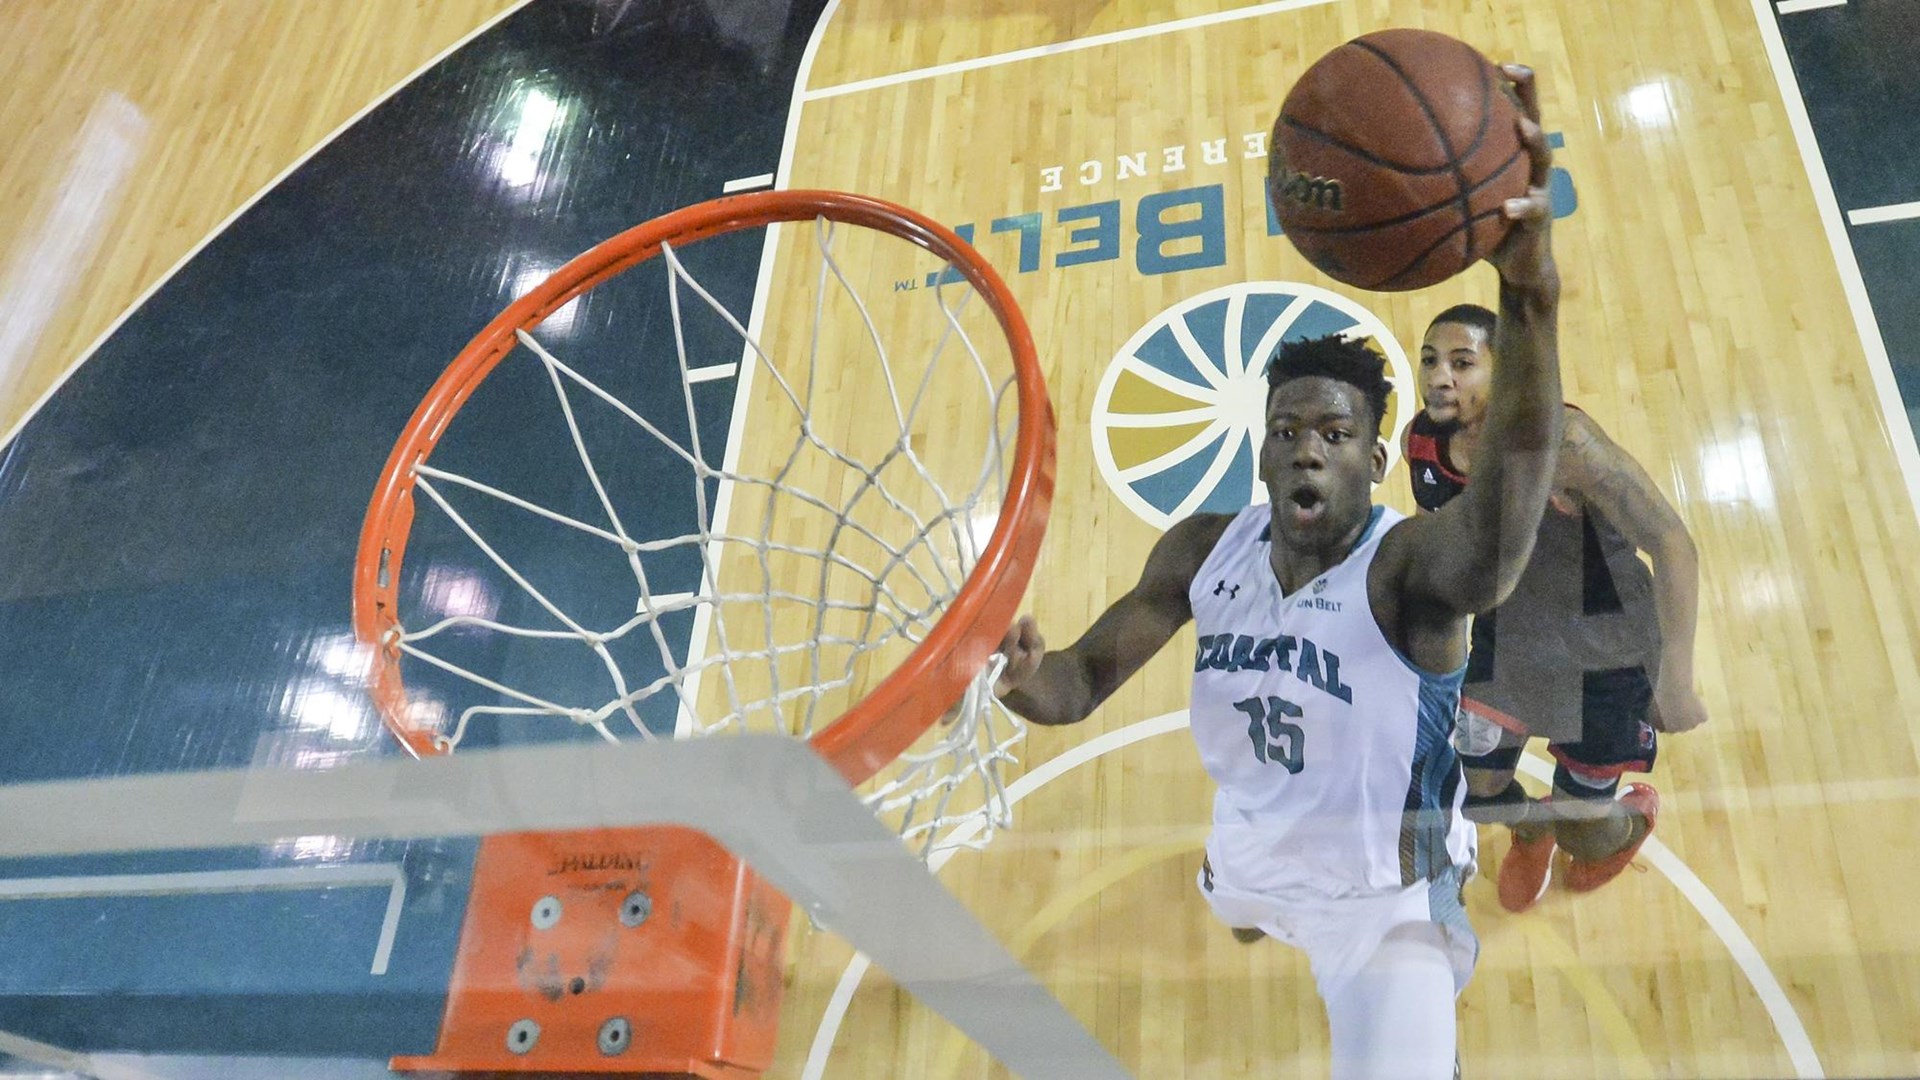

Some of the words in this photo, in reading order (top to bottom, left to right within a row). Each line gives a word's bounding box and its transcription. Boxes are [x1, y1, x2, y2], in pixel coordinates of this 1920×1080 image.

[1040, 131, 1268, 193] ERENCE
[1297, 598, 1313, 609] UN
[1195, 632, 1353, 705] COASTAL
[1233, 695, 1305, 775] 15
